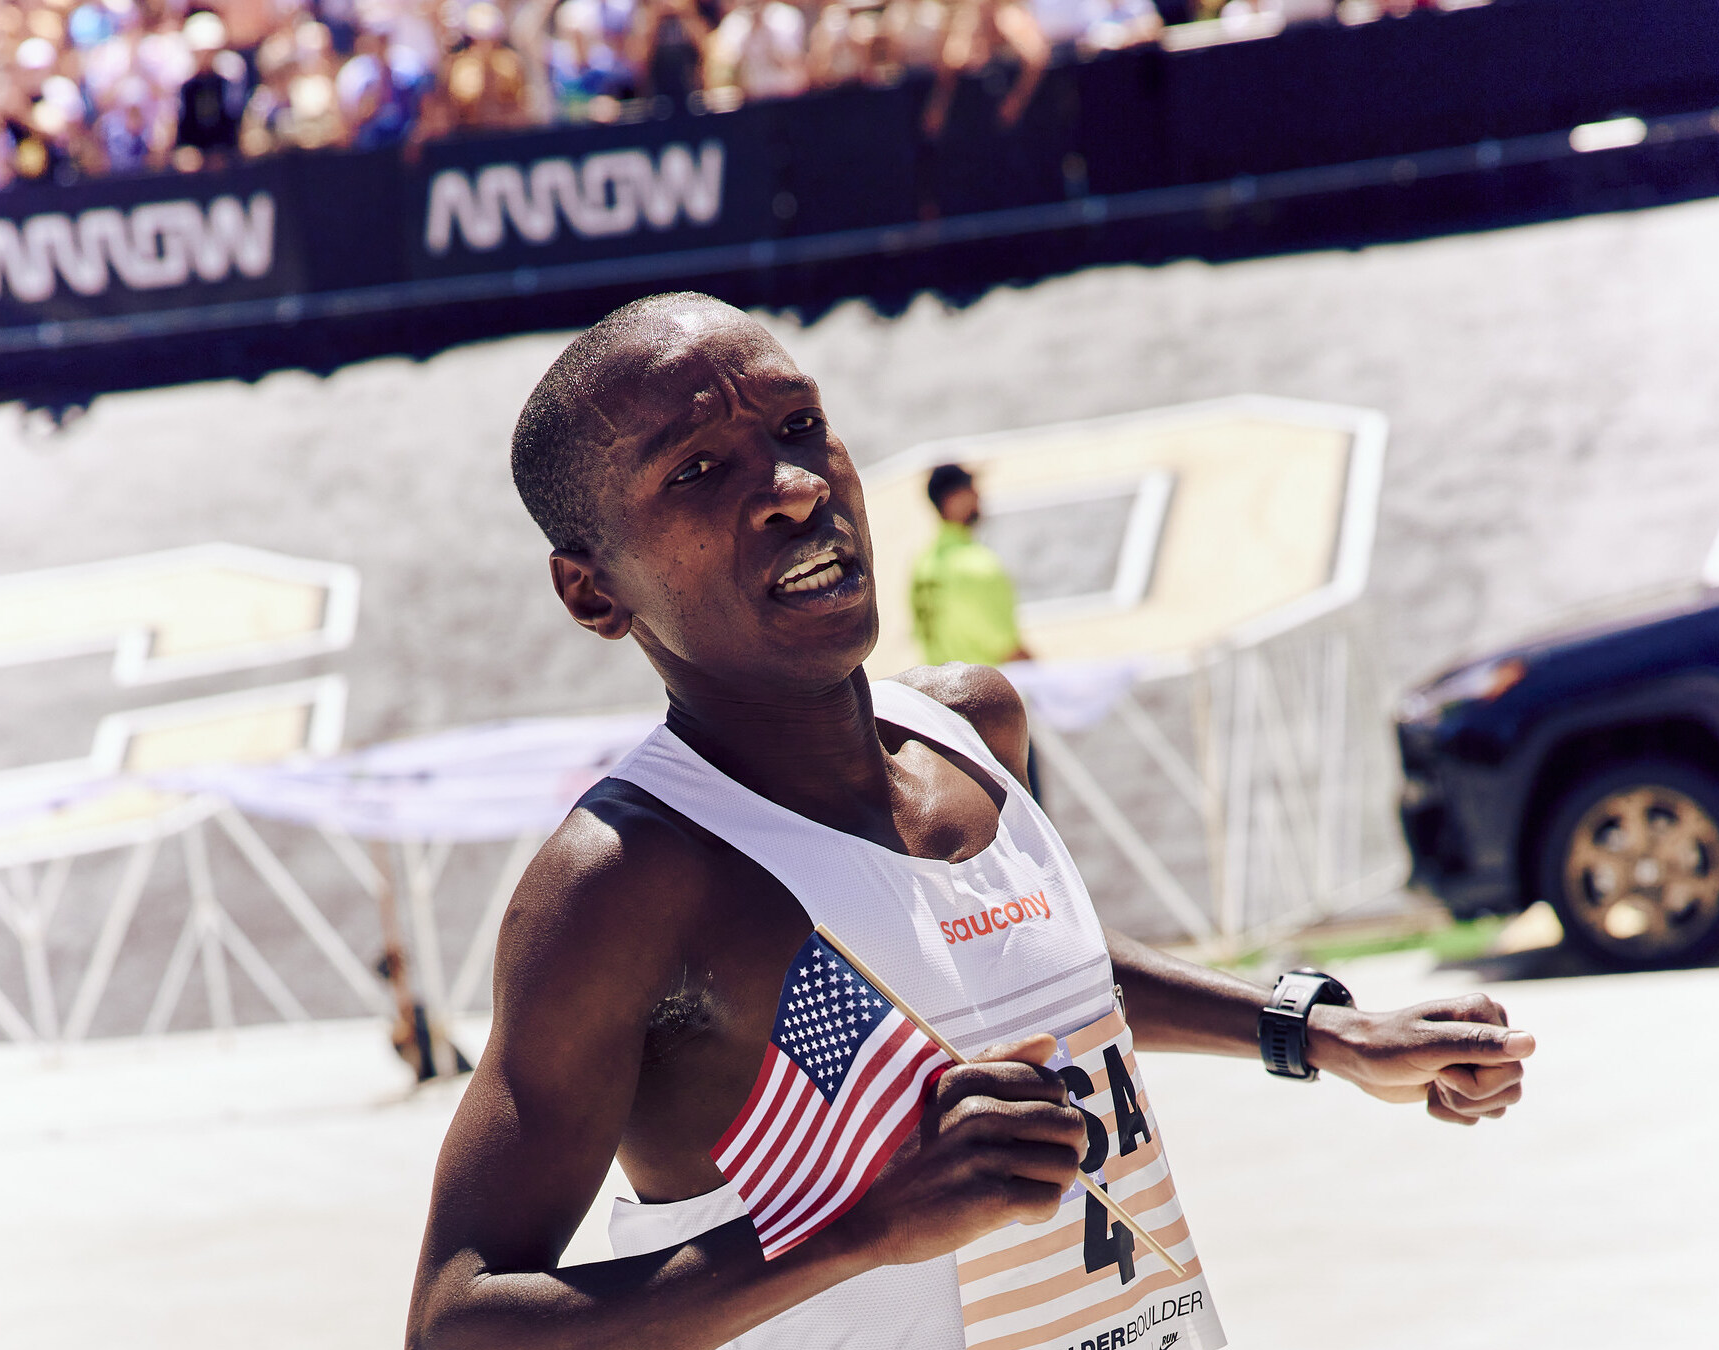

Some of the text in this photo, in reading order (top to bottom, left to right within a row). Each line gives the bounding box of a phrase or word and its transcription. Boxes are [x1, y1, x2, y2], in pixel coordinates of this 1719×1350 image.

[939, 890, 1050, 944] saucony
[1057, 1043, 1152, 1174] SA
[1083, 1182, 1136, 1286] 4
[1161, 1331, 1179, 1347] RUN
